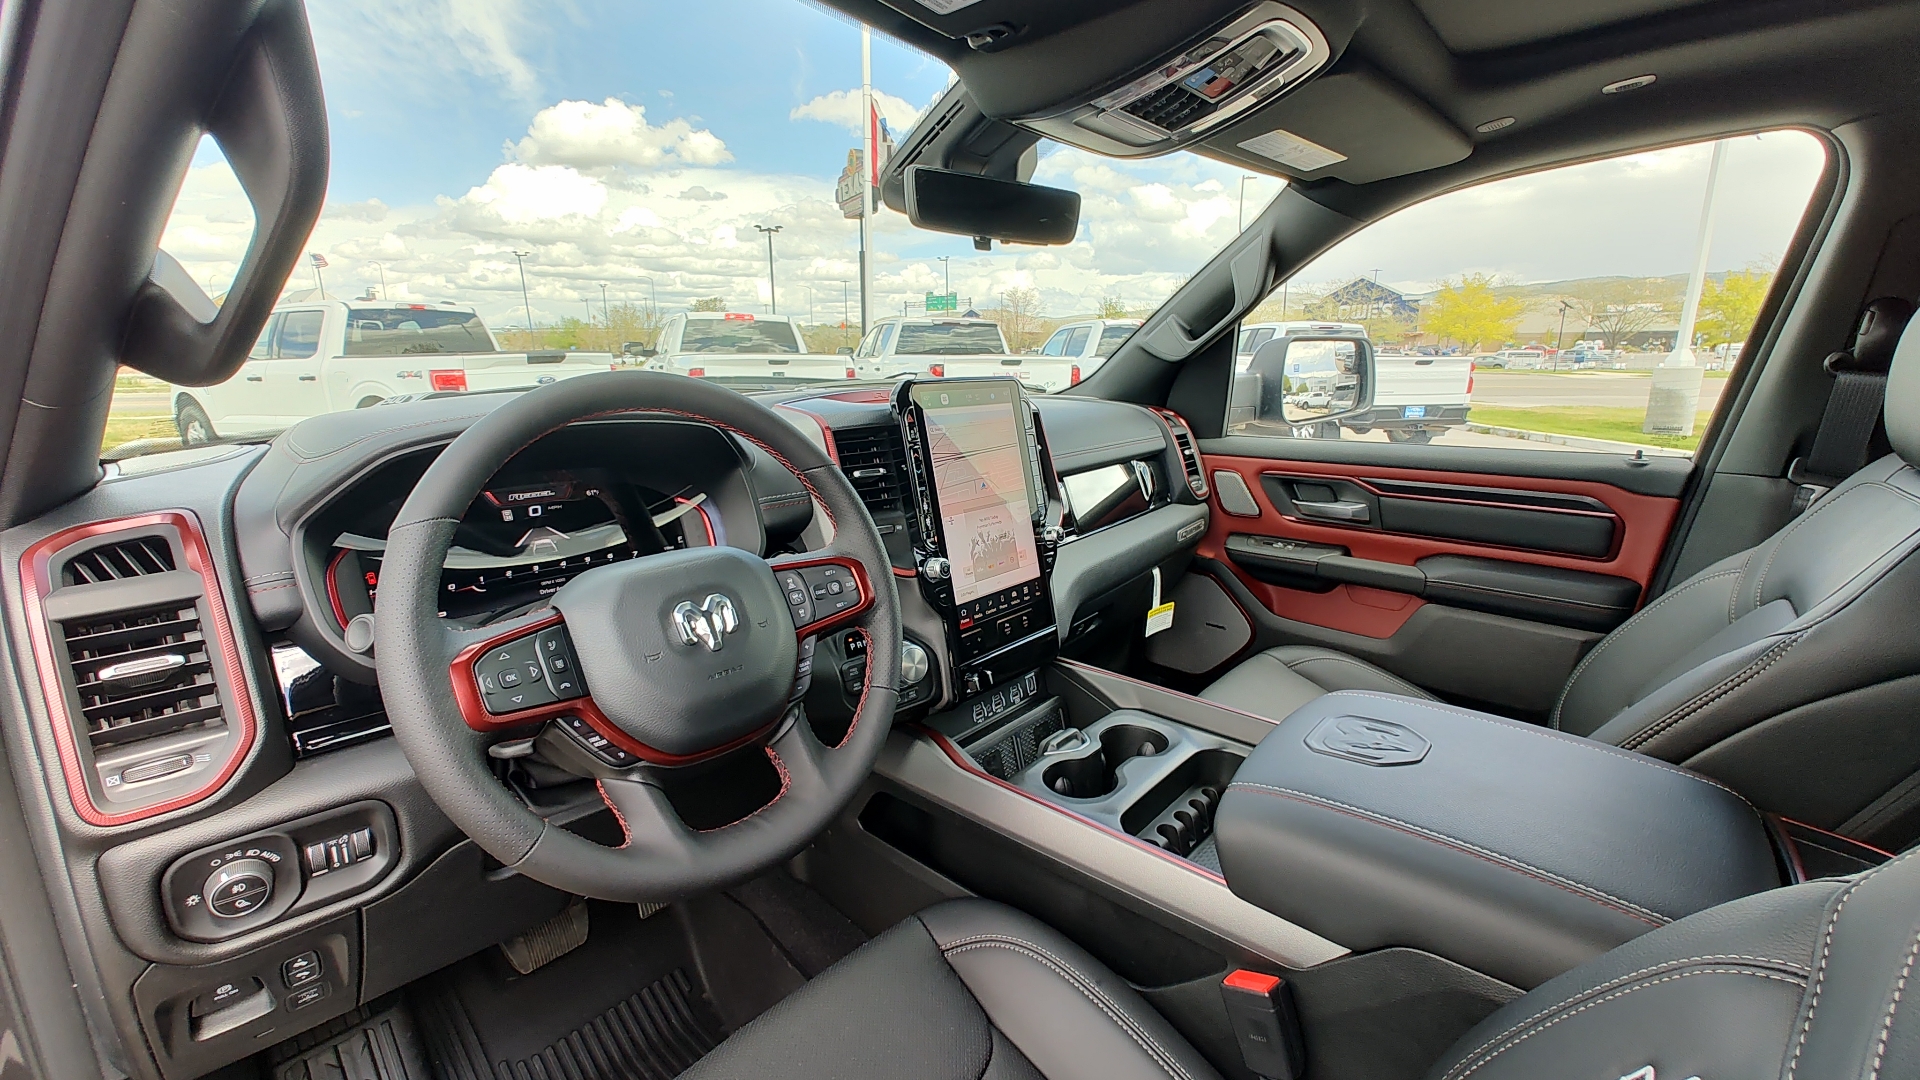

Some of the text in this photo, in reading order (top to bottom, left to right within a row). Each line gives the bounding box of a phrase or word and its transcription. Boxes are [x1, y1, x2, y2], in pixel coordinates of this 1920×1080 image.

[1327, 301, 1393, 320] OWE'S
[528, 505, 542, 517] 0
[539, 587, 556, 595] Driver
[504, 673, 517, 682] OK
[260, 850, 281, 862] AUTO
